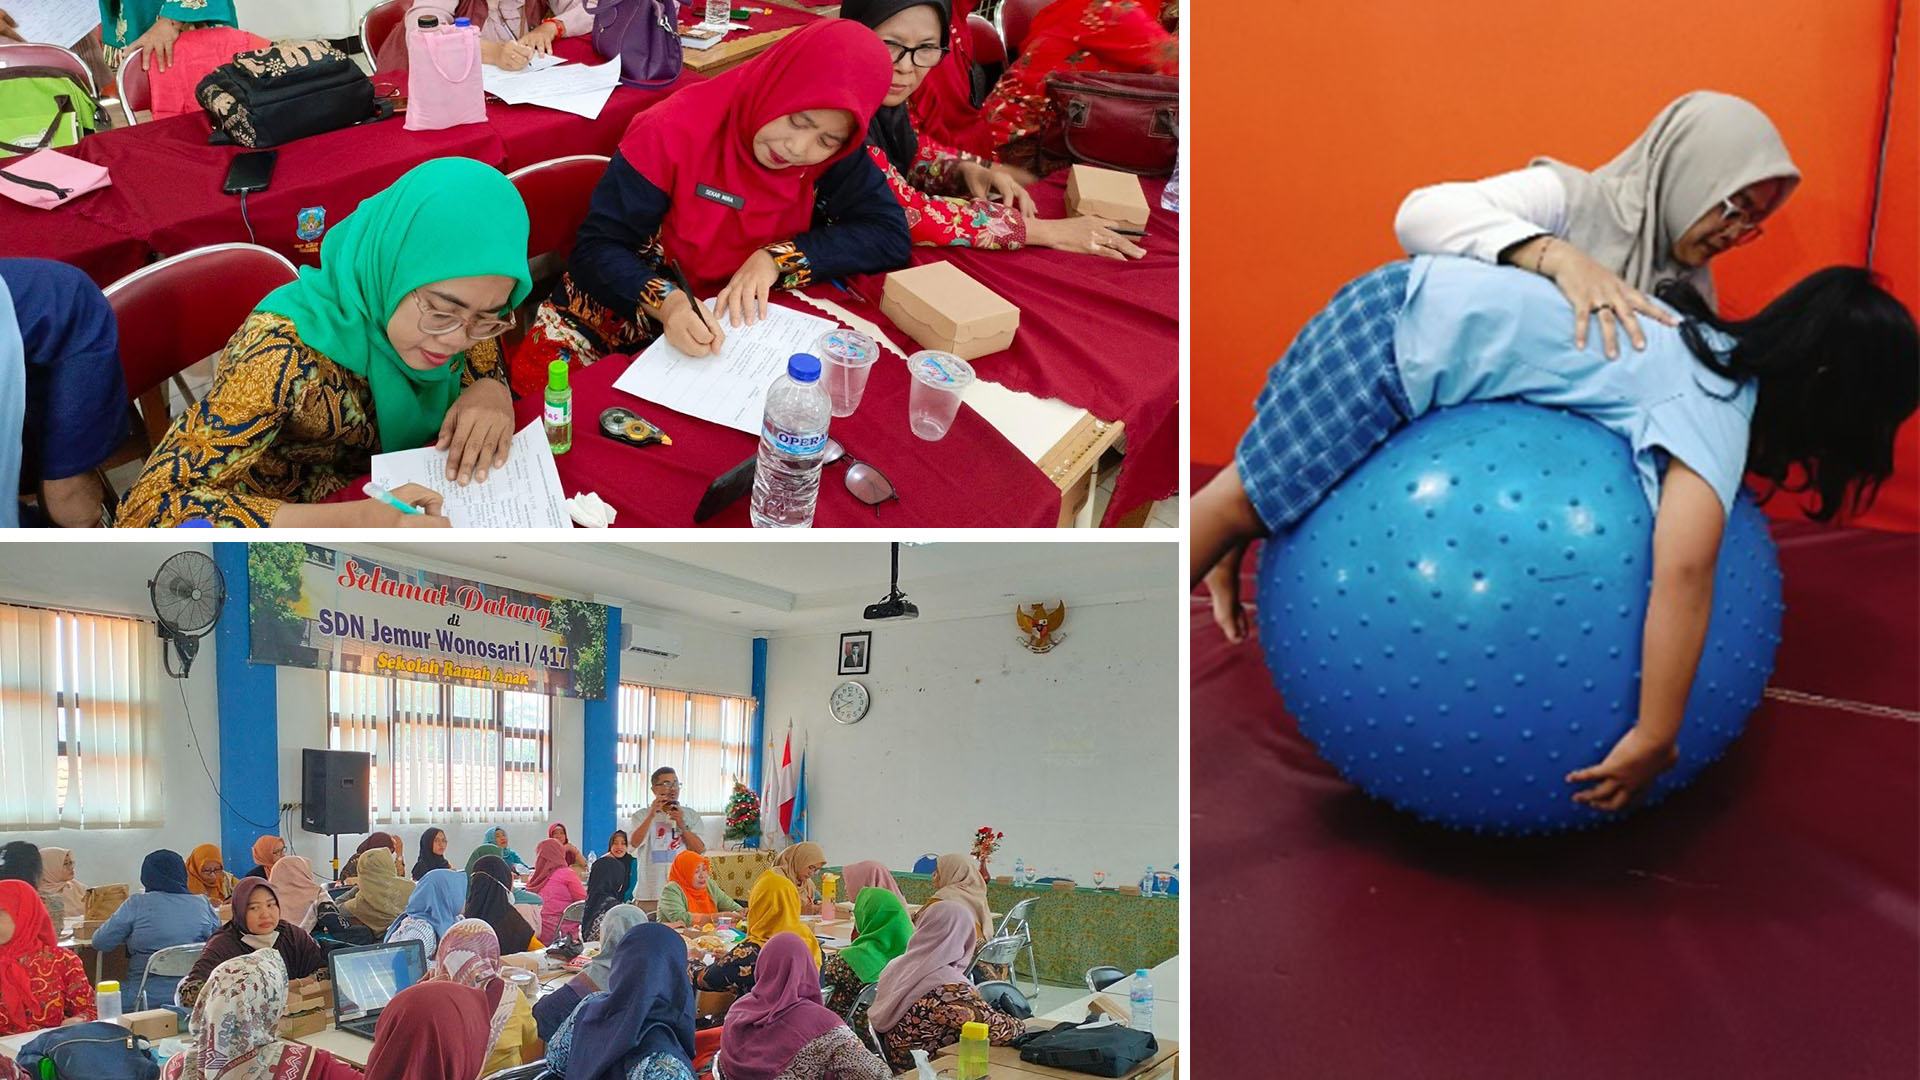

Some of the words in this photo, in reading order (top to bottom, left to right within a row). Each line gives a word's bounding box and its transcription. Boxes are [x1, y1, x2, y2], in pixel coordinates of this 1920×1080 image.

[337, 560, 449, 606] Selamat
[455, 585, 551, 629] Datang
[318, 608, 365, 640] SDN
[371, 618, 431, 649] Jemur
[435, 628, 520, 663] Wonosari
[447, 613, 461, 627] di
[376, 651, 439, 676] Sekolah
[442, 661, 491, 682] Ramah
[493, 667, 529, 686] Anak
